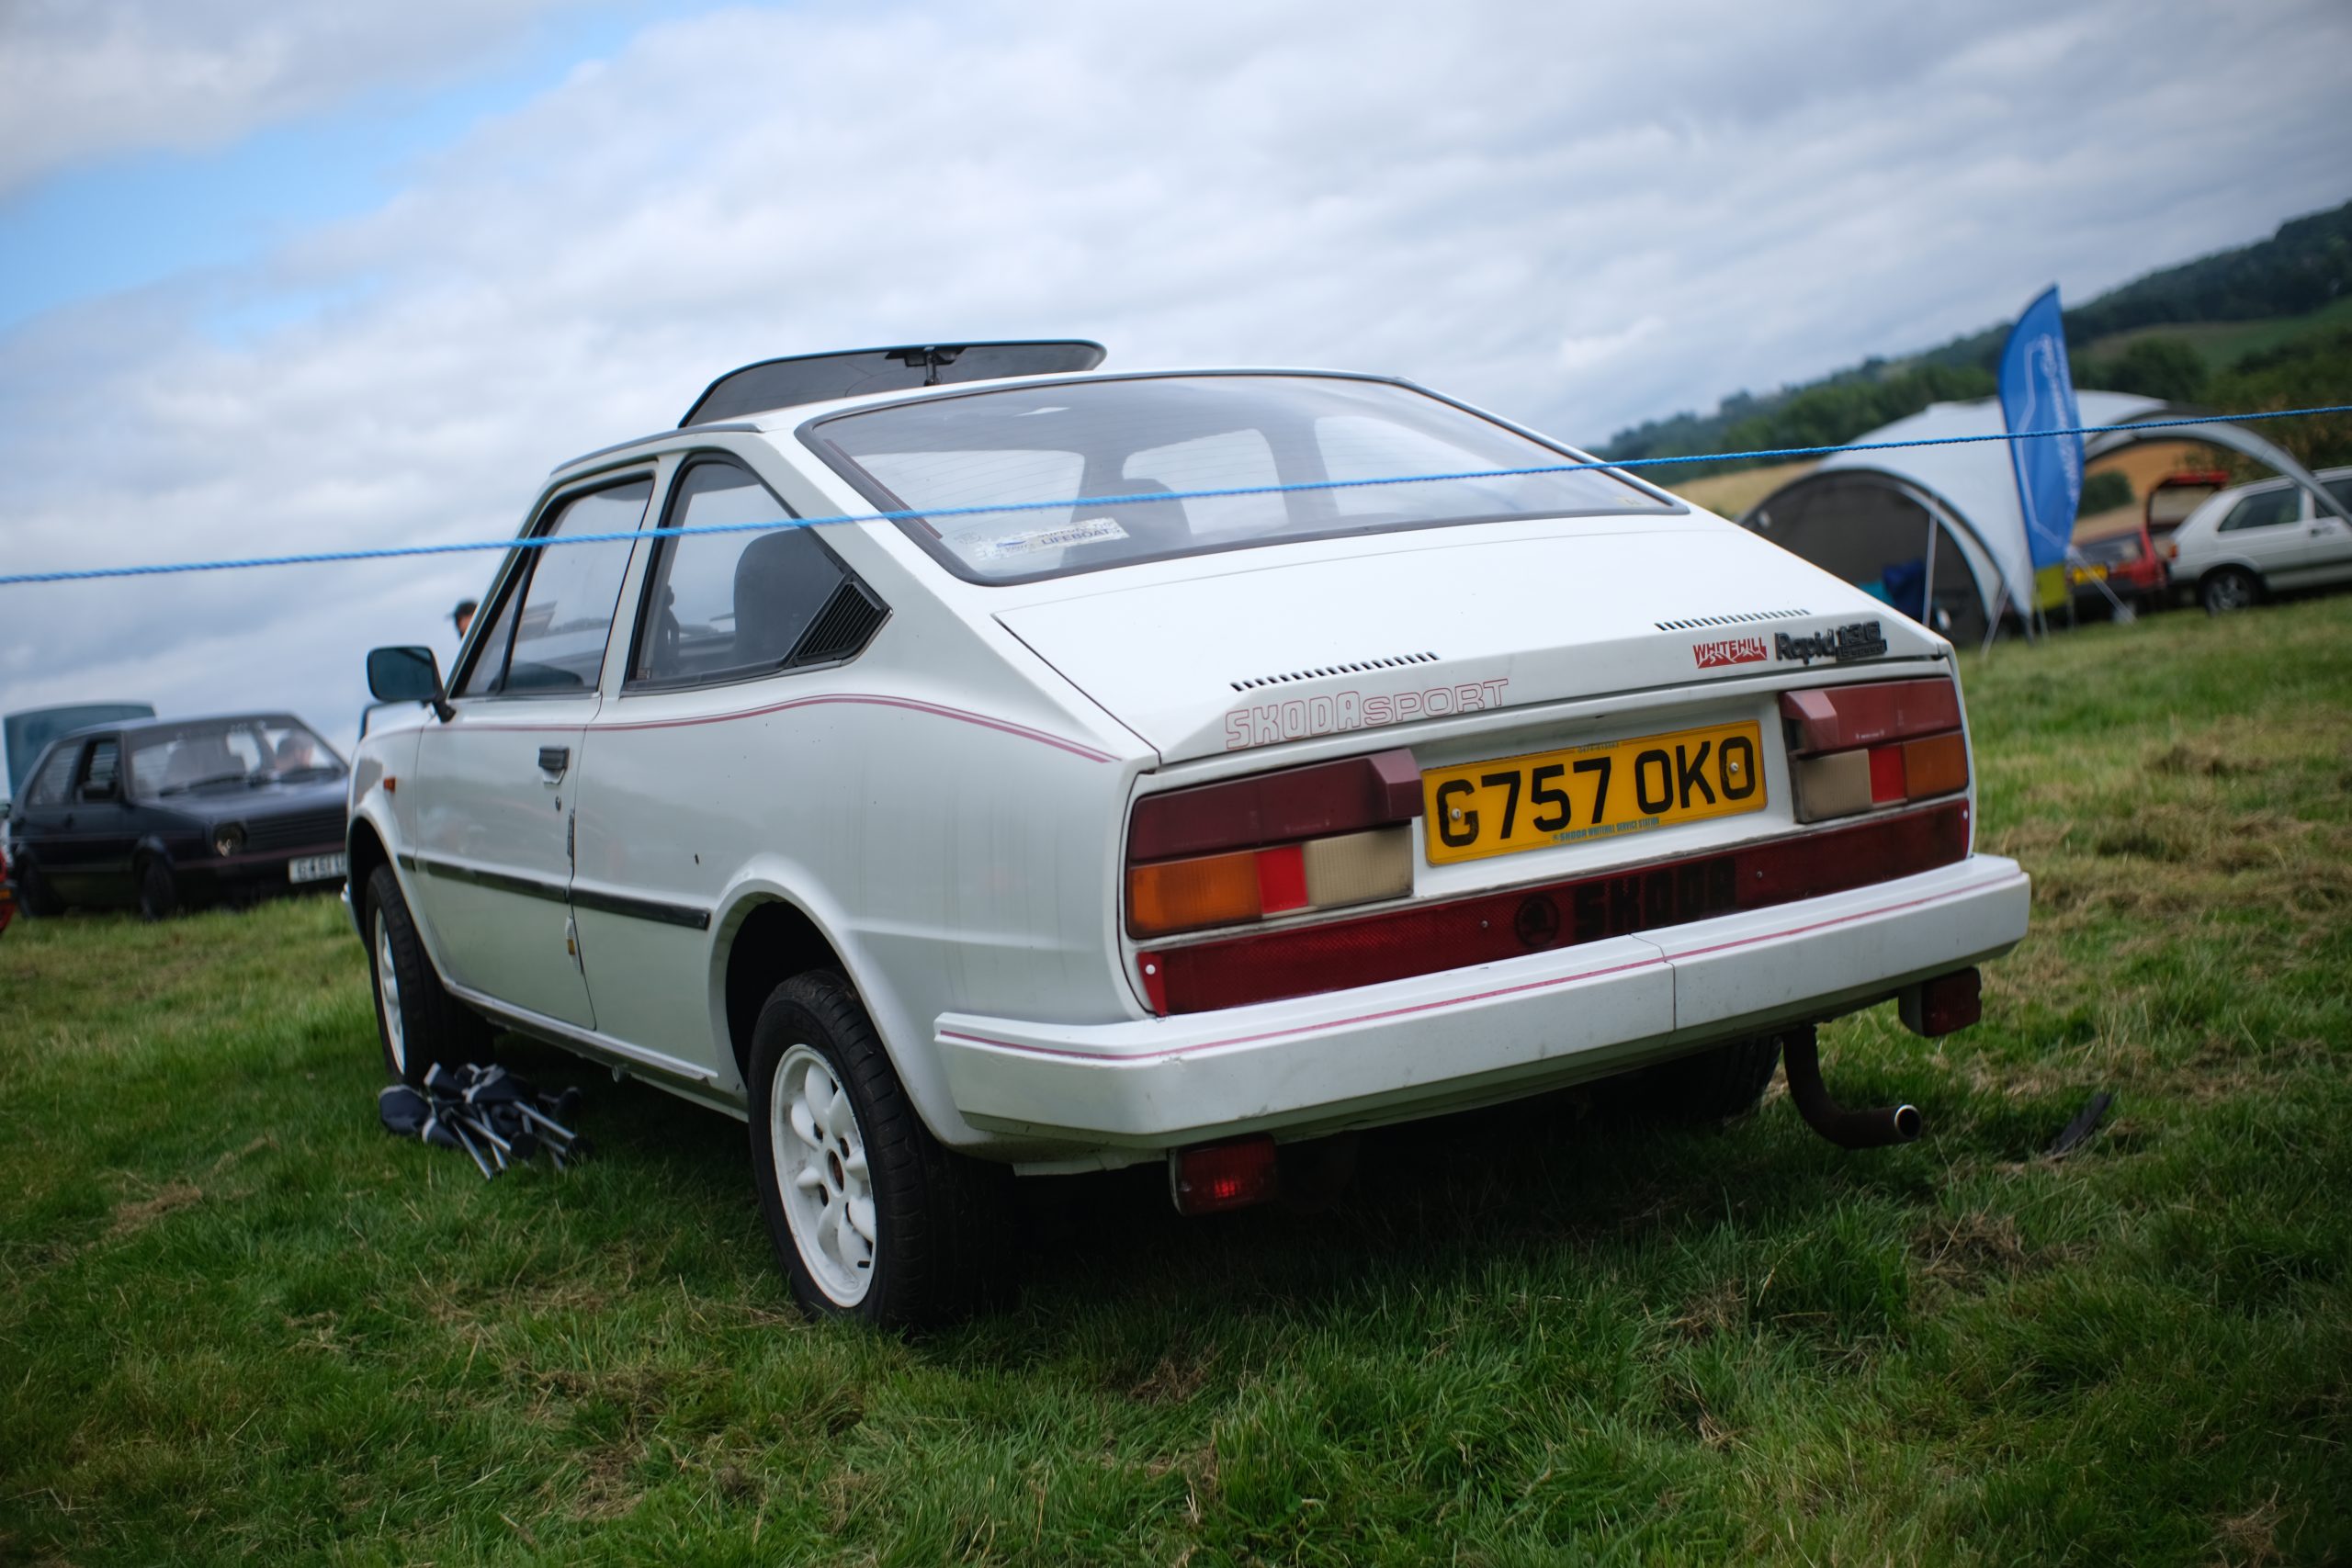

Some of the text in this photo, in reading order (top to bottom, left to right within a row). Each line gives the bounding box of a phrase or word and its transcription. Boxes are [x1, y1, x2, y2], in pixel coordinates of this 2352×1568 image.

[1693, 637, 1767, 661] WHITEHILL
[1774, 628, 1836, 666] Rapid
[1436, 736, 1756, 848] G757 OKO
[1575, 855, 1736, 940] SKODA
